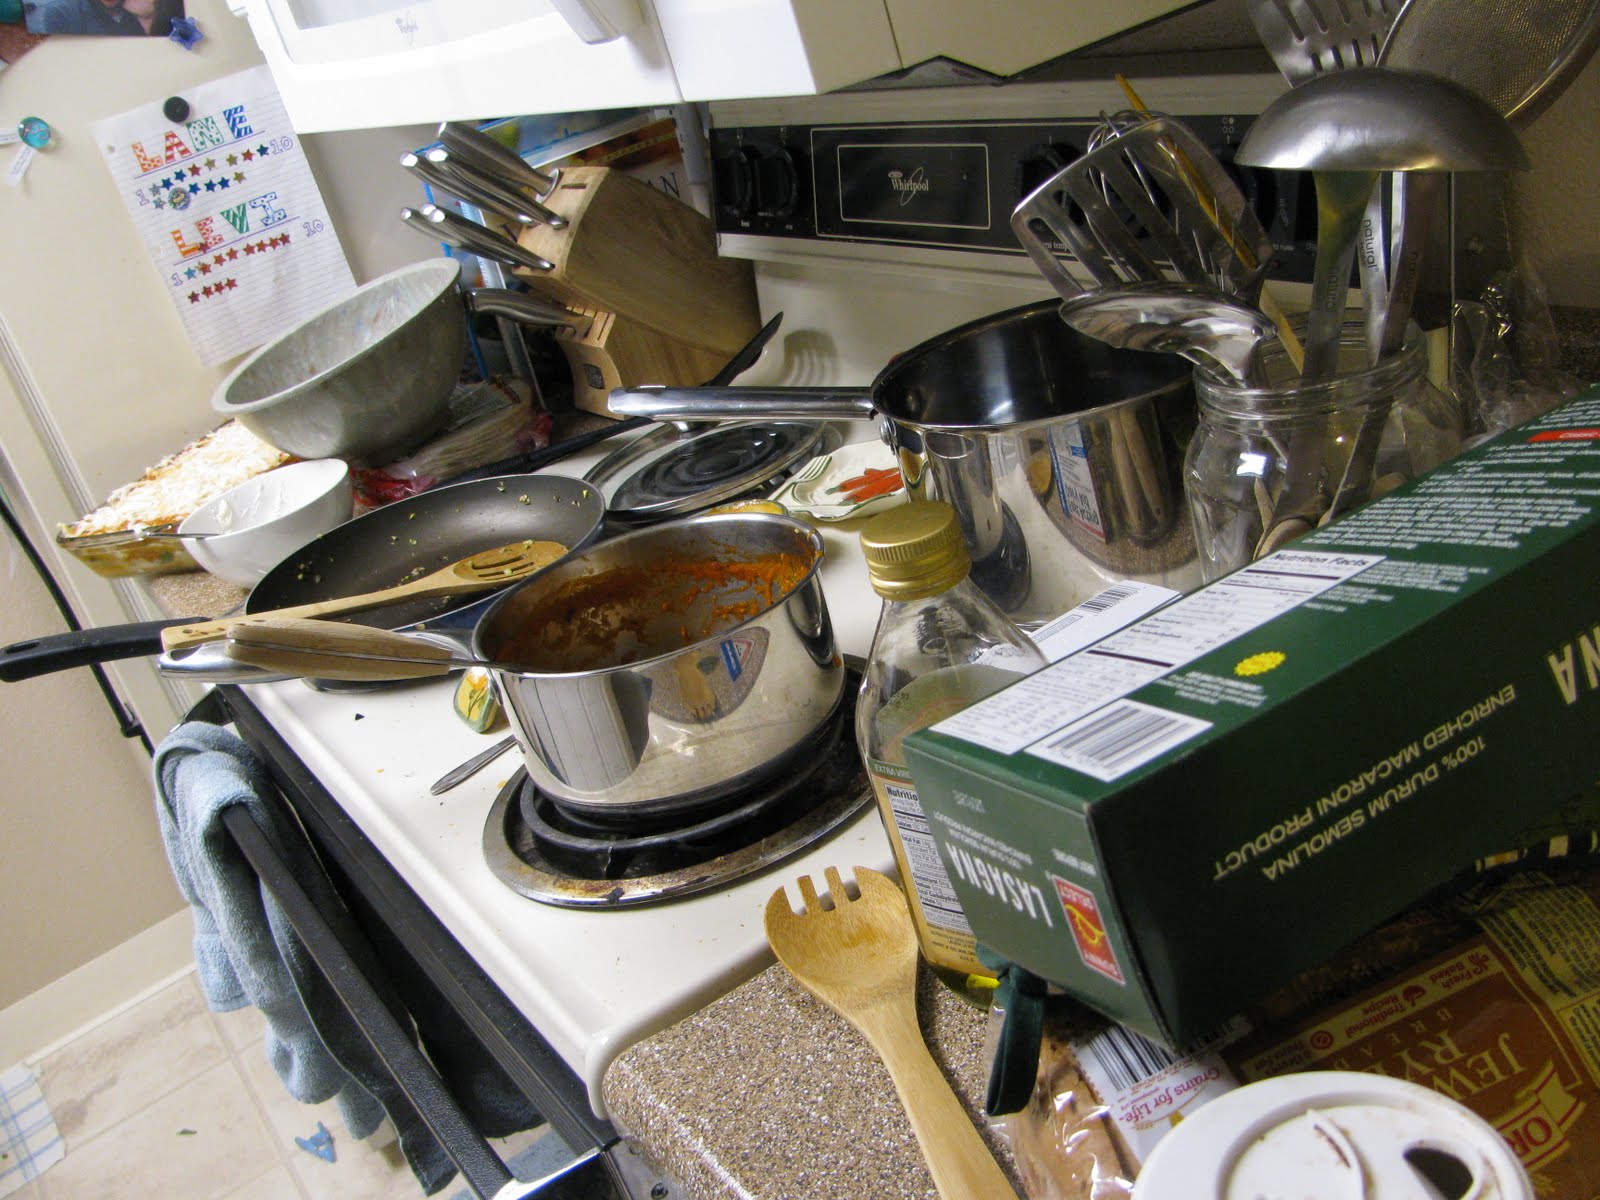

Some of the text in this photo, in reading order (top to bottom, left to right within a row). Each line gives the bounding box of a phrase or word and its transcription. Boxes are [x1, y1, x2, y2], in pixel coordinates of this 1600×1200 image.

[131, 105, 253, 173] LANE
[270, 136, 293, 155] 10
[891, 178, 929, 191] Whirlpool
[171, 192, 287, 258] LEVI
[303, 219, 324, 237] 10
[1363, 219, 1378, 270] natural
[1271, 553, 1369, 567] Nutrition Facts
[875, 764, 896, 776] EXTRA
[1212, 684, 1518, 881] ENRICHED MACARONI PRODUCT
[886, 786, 918, 801] Nutritio
[1262, 735, 1487, 881] 100% DURUM SEMOLINA
[945, 841, 1053, 928] LASAGNA
[1429, 961, 1465, 984] Baked
[1441, 970, 1473, 989] Fresh
[1344, 1003, 1407, 1038] Traditional
[1361, 994, 1399, 1016] Recipe
[1334, 1008, 1453, 1071] BREAD
[1432, 1032, 1527, 1101] JEW
[1125, 1068, 1220, 1123] Grains for Life
